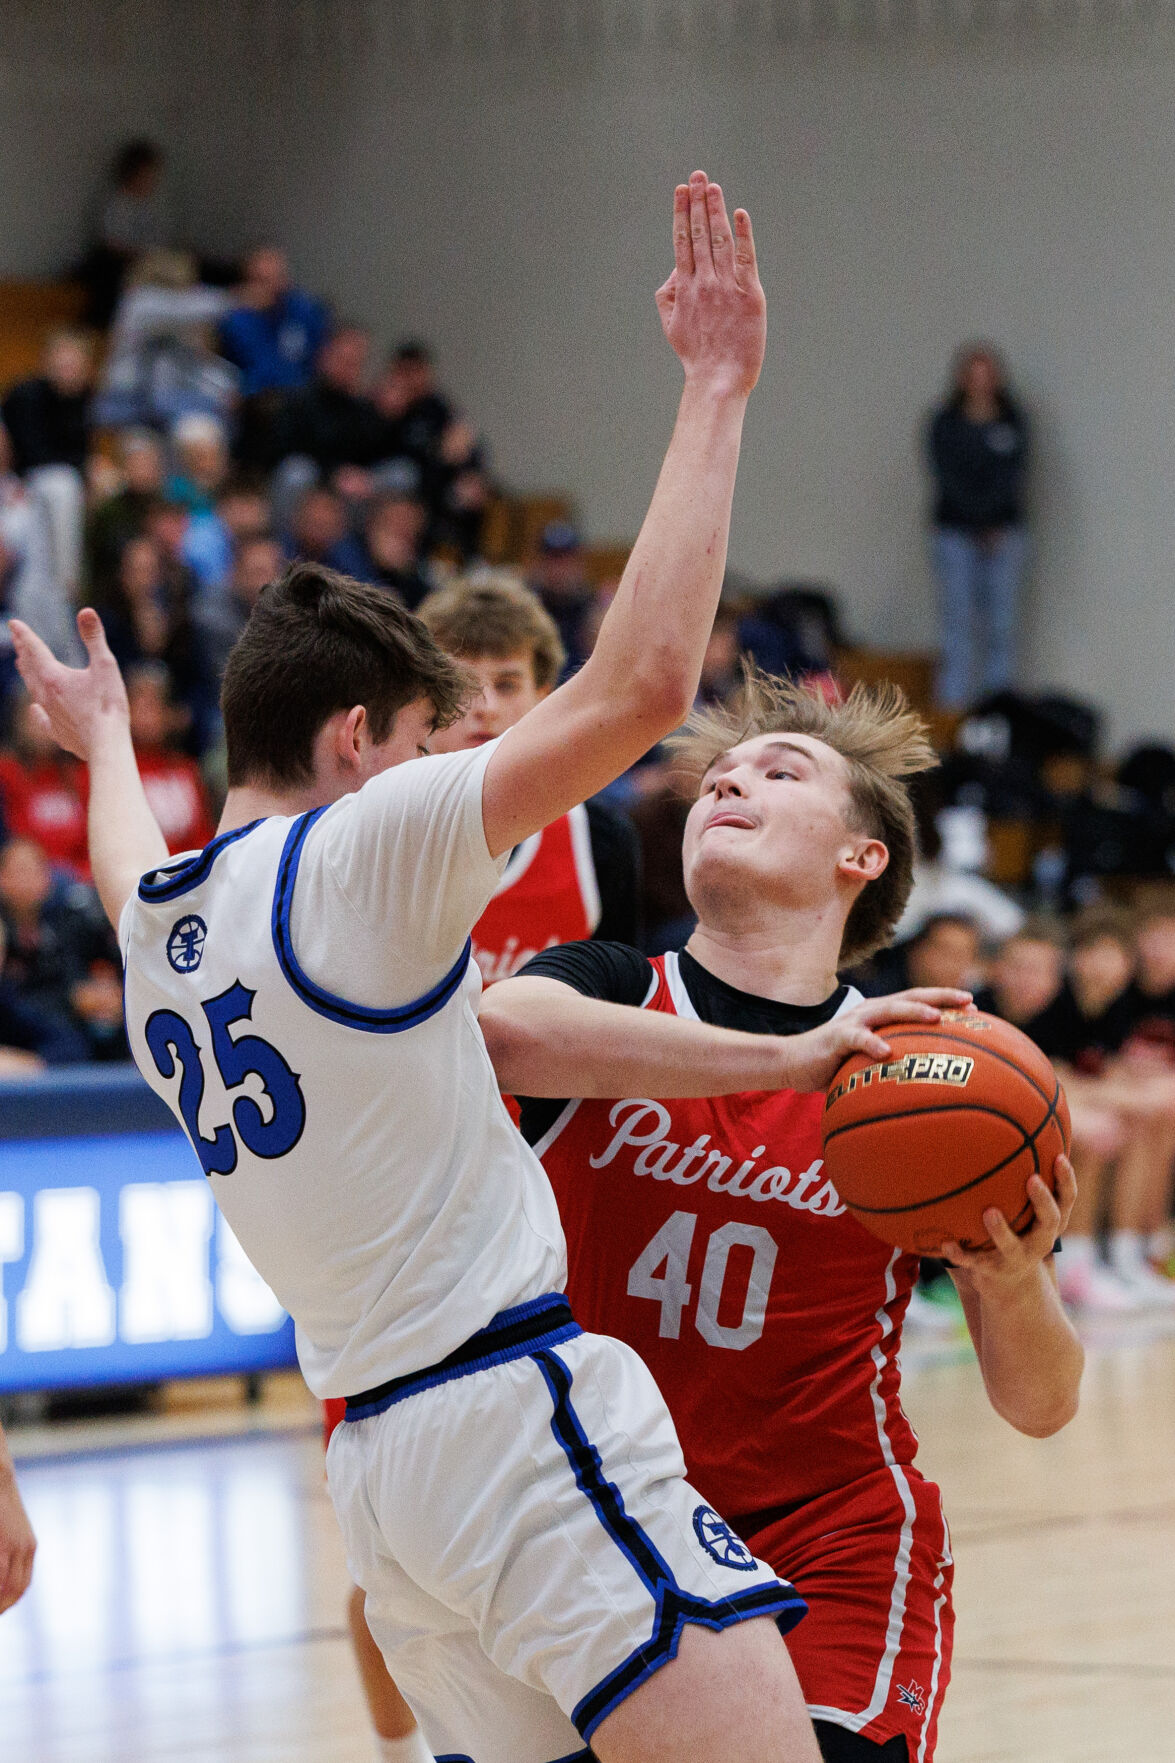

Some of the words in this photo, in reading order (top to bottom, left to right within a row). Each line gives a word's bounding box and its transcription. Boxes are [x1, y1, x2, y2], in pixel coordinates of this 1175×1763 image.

[145, 977, 307, 1177] 25
[909, 1058, 968, 1082] PRO
[588, 1098, 848, 1217] Patriots
[626, 1210, 779, 1351] 40
